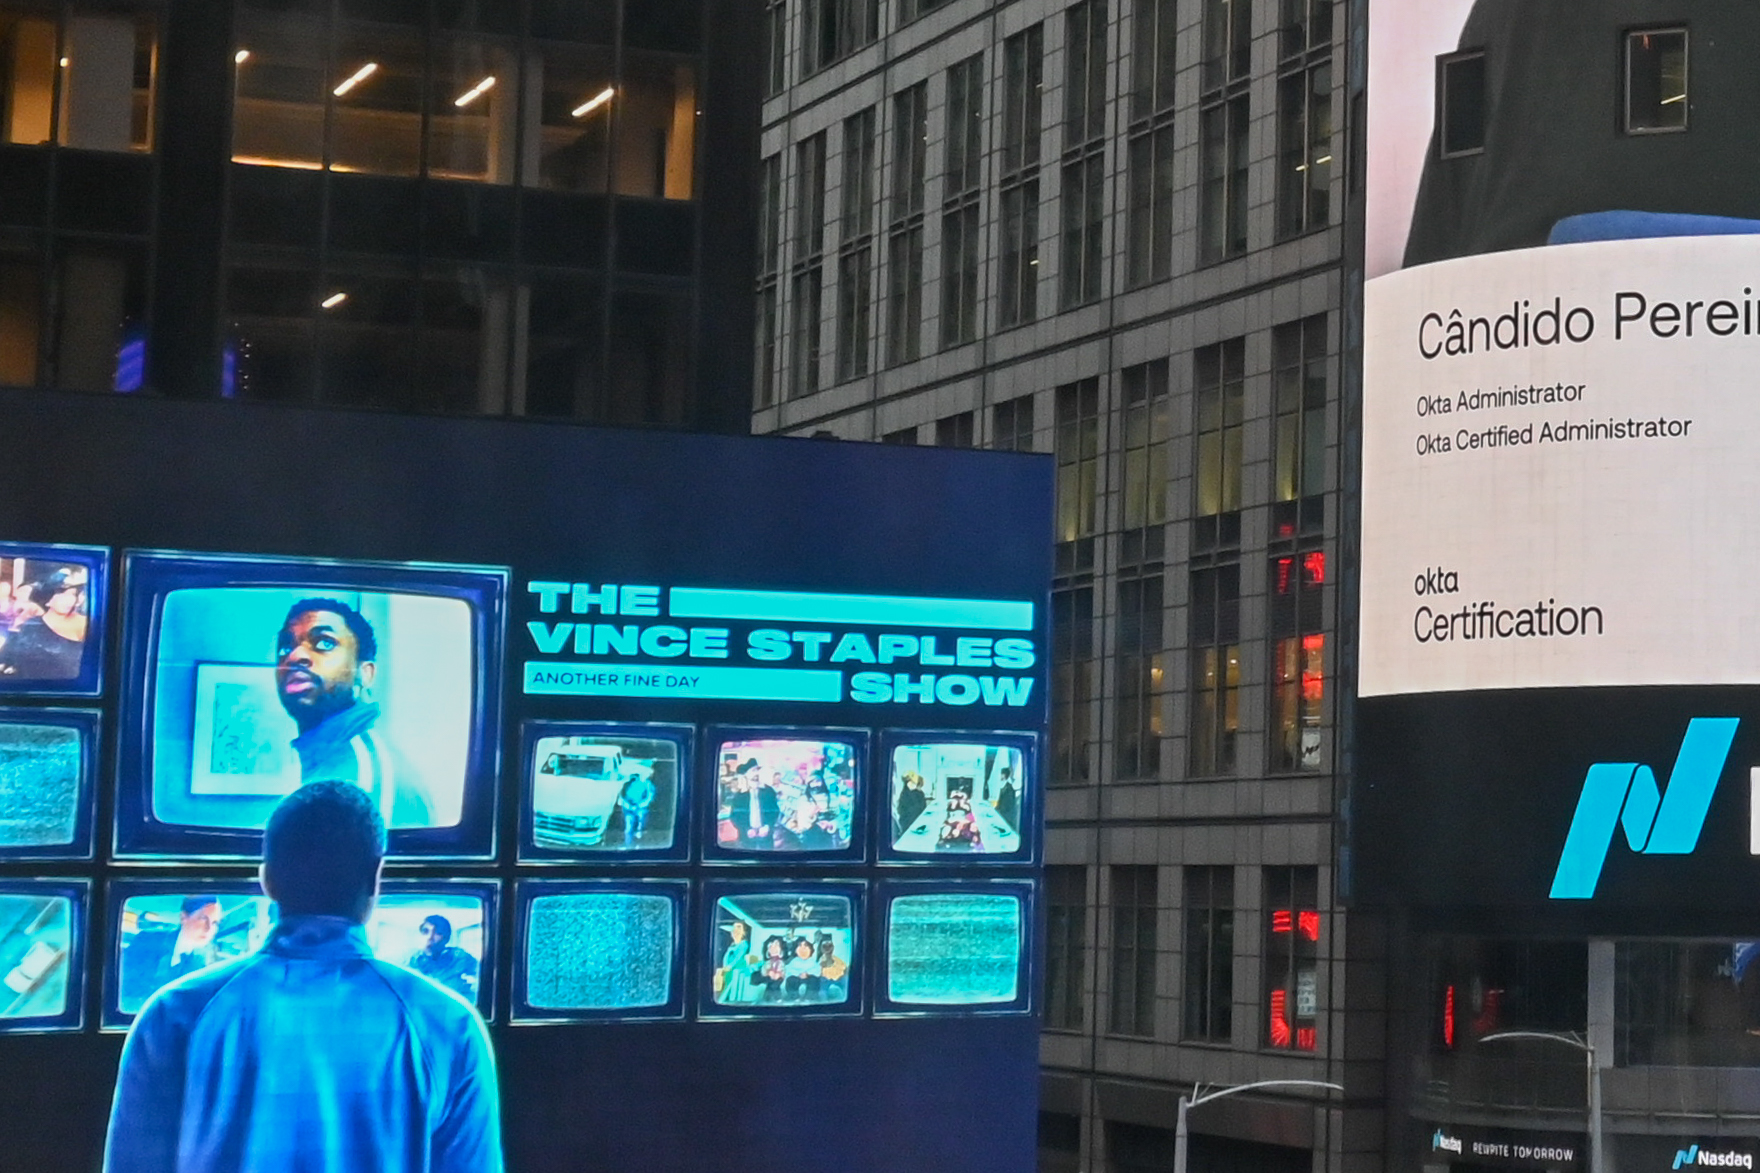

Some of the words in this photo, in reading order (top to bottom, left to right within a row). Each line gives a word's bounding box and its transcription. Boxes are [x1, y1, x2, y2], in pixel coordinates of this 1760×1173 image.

[1418, 296, 1595, 360] Cândido
[1416, 395, 1452, 417] Okta
[1456, 382, 1587, 412] Administrator
[1416, 433, 1452, 456] Okta
[1455, 422, 1533, 451] Certified
[1538, 415, 1693, 444] Administrator
[527, 581, 661, 616] THE
[1414, 566, 1459, 596] okta
[1414, 597, 1604, 643] Certification
[526, 622, 730, 659] VINCE
[746, 628, 1036, 669] STAPLES
[532, 671, 619, 687] ANOTHER
[624, 674, 661, 688] FINE
[665, 675, 700, 689] DAY
[849, 671, 1035, 707] SHOW
[1472, 1141, 1509, 1157] REWRITE
[1513, 1145, 1574, 1161] TOMORROW
[1698, 1150, 1753, 1170] Nasdaq
